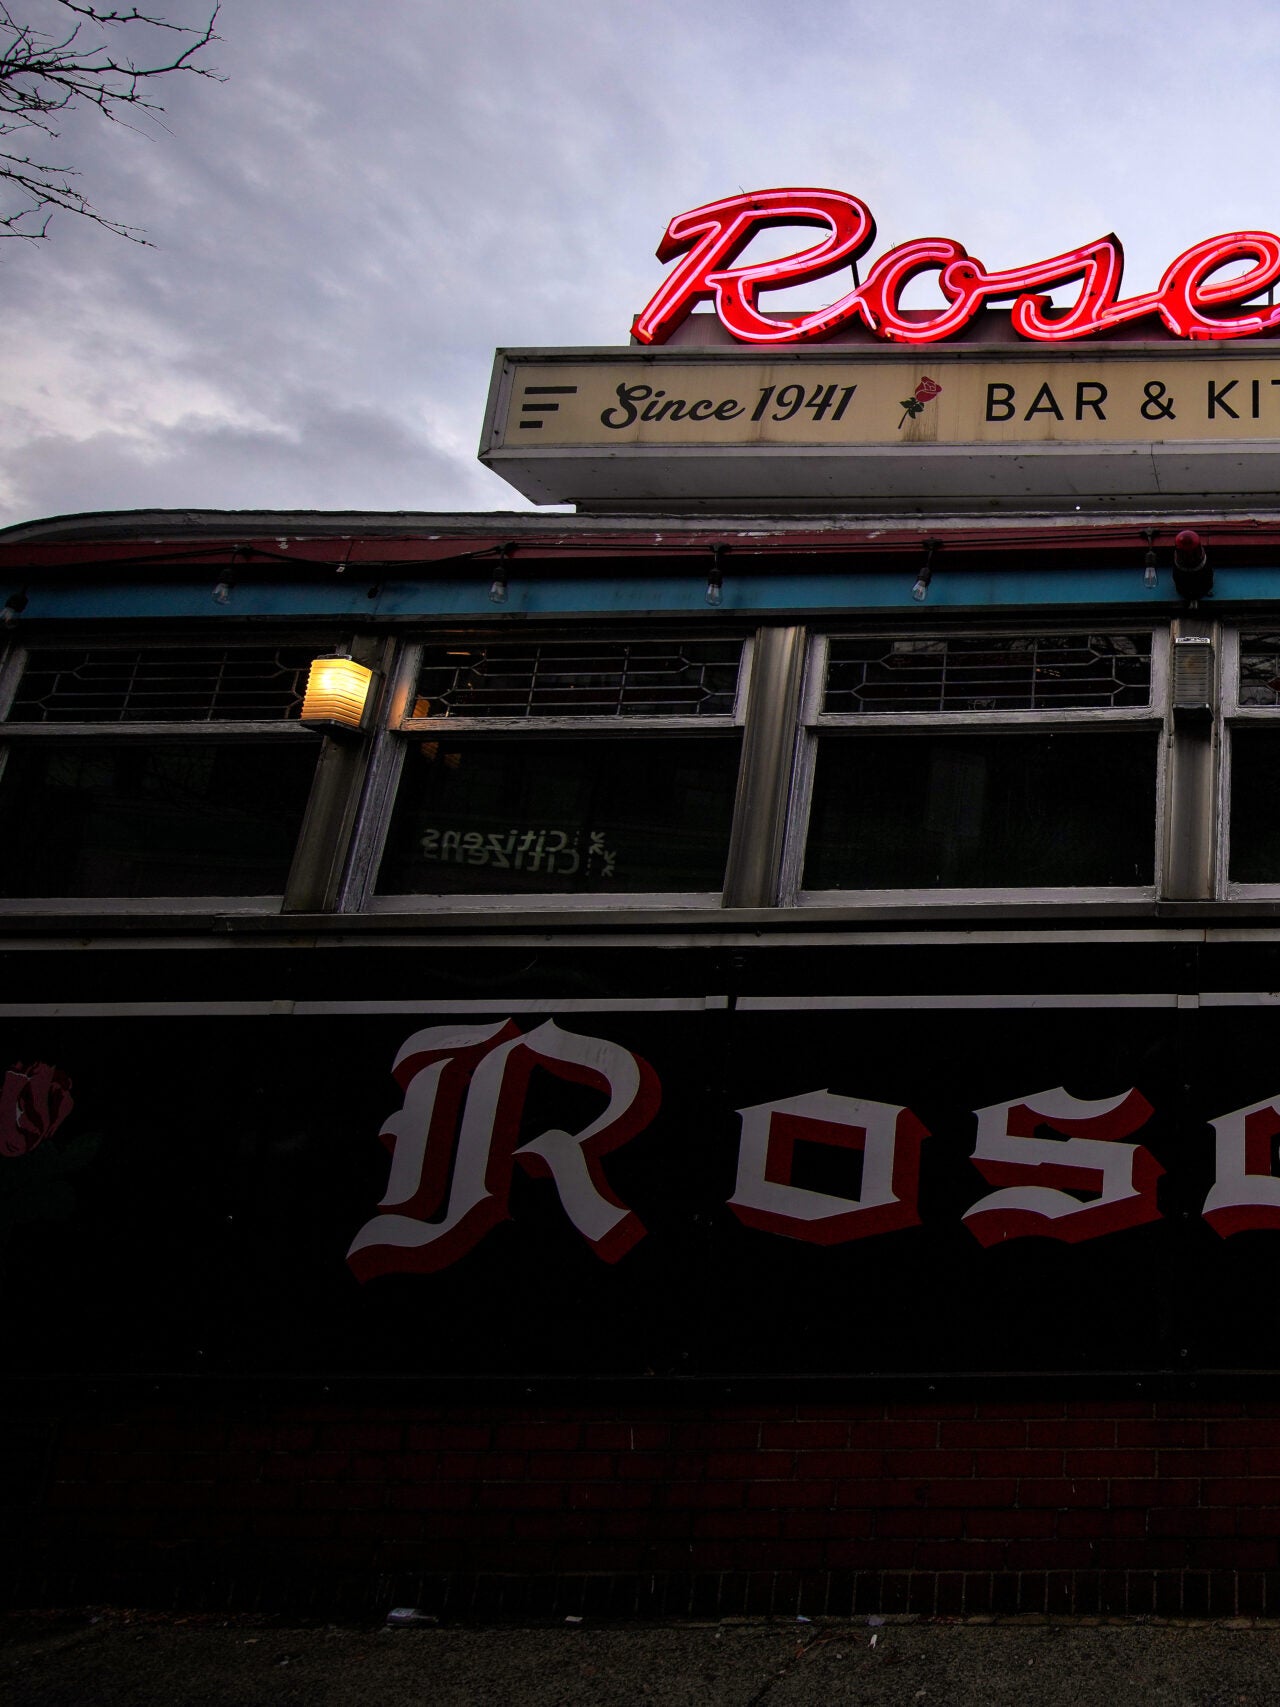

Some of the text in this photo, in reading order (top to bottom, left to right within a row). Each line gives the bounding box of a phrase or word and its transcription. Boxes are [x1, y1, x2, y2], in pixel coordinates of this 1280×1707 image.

[600, 382, 857, 430] Since 1941
[986, 381, 1107, 421] BAR
[1142, 380, 1176, 420] &
